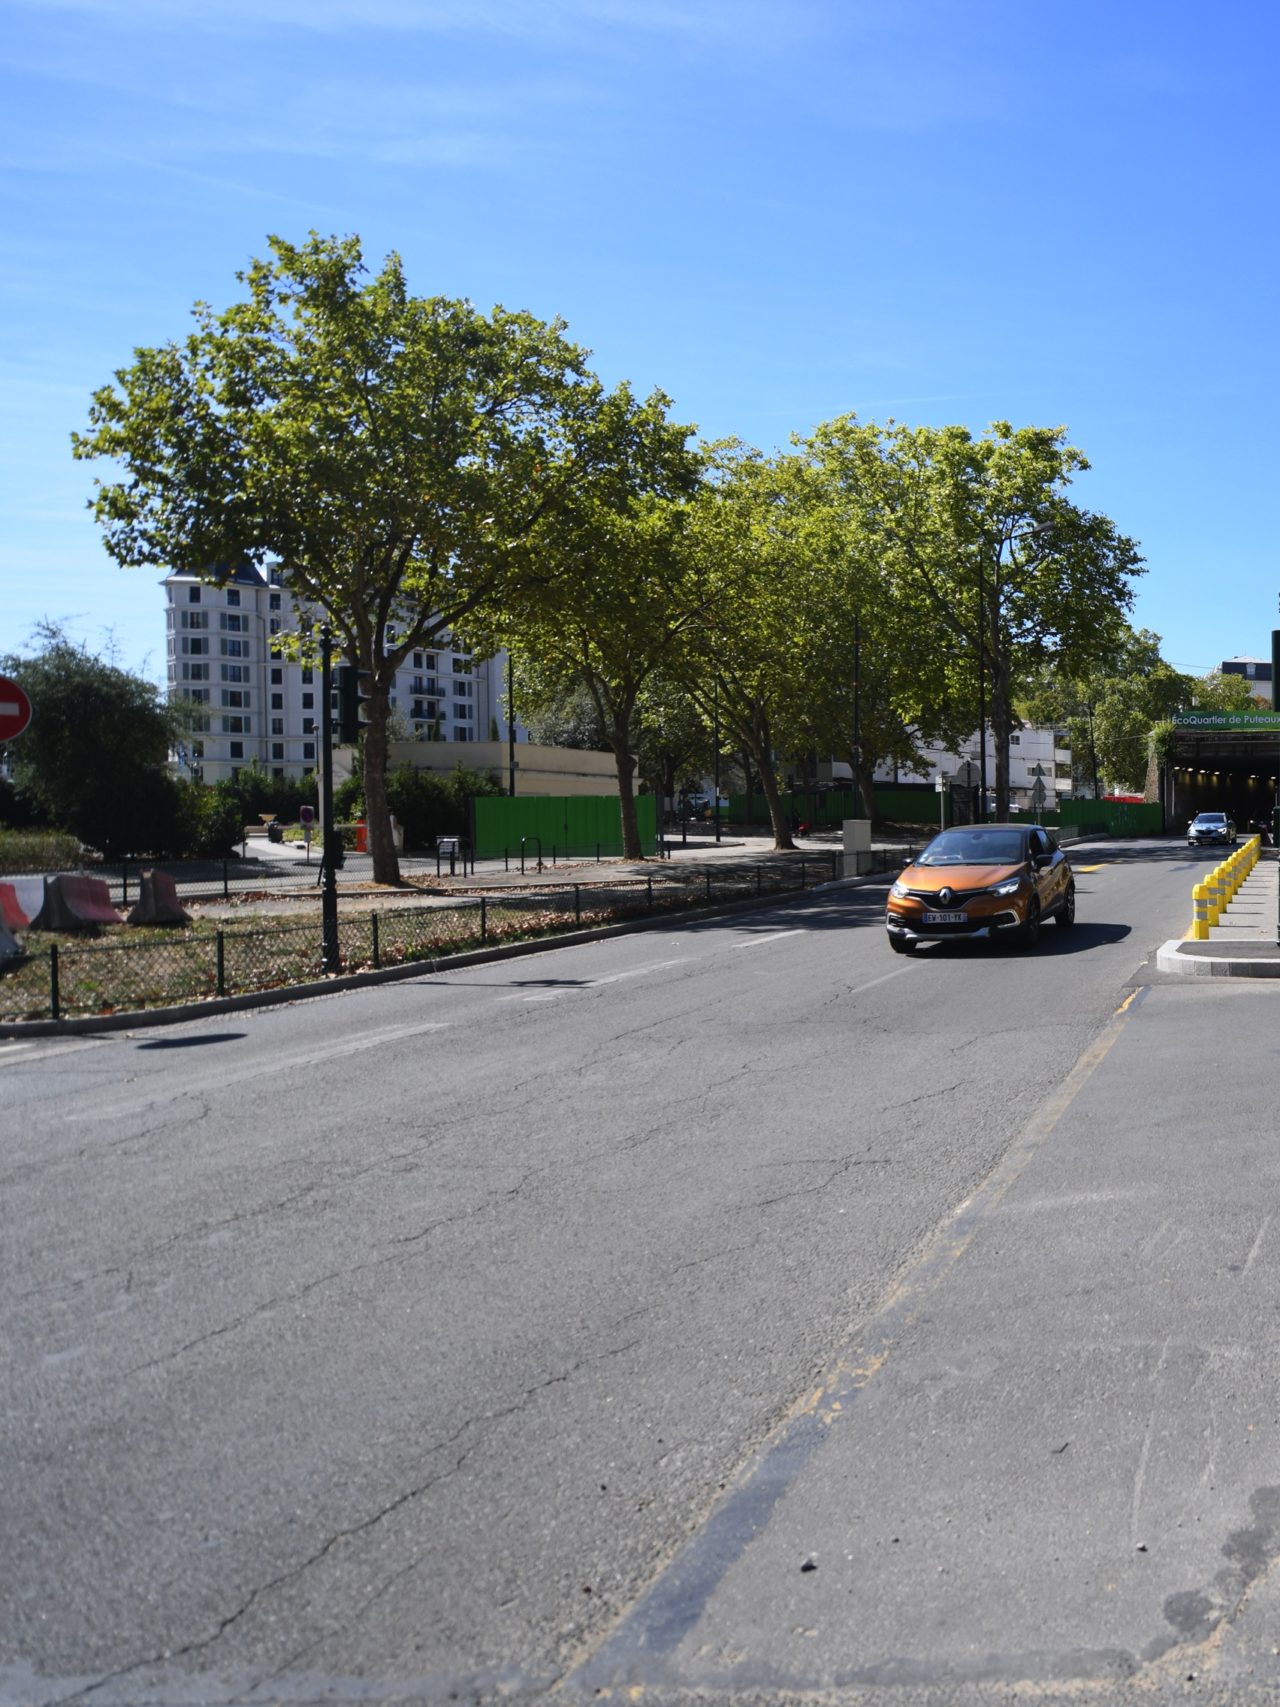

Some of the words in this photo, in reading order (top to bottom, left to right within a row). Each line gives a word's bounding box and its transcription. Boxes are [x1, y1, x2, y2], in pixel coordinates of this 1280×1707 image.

[1172, 714, 1226, 725] ÉcoQuartier
[1229, 715, 1241, 724] de
[1244, 715, 1280, 724] Puteaux
